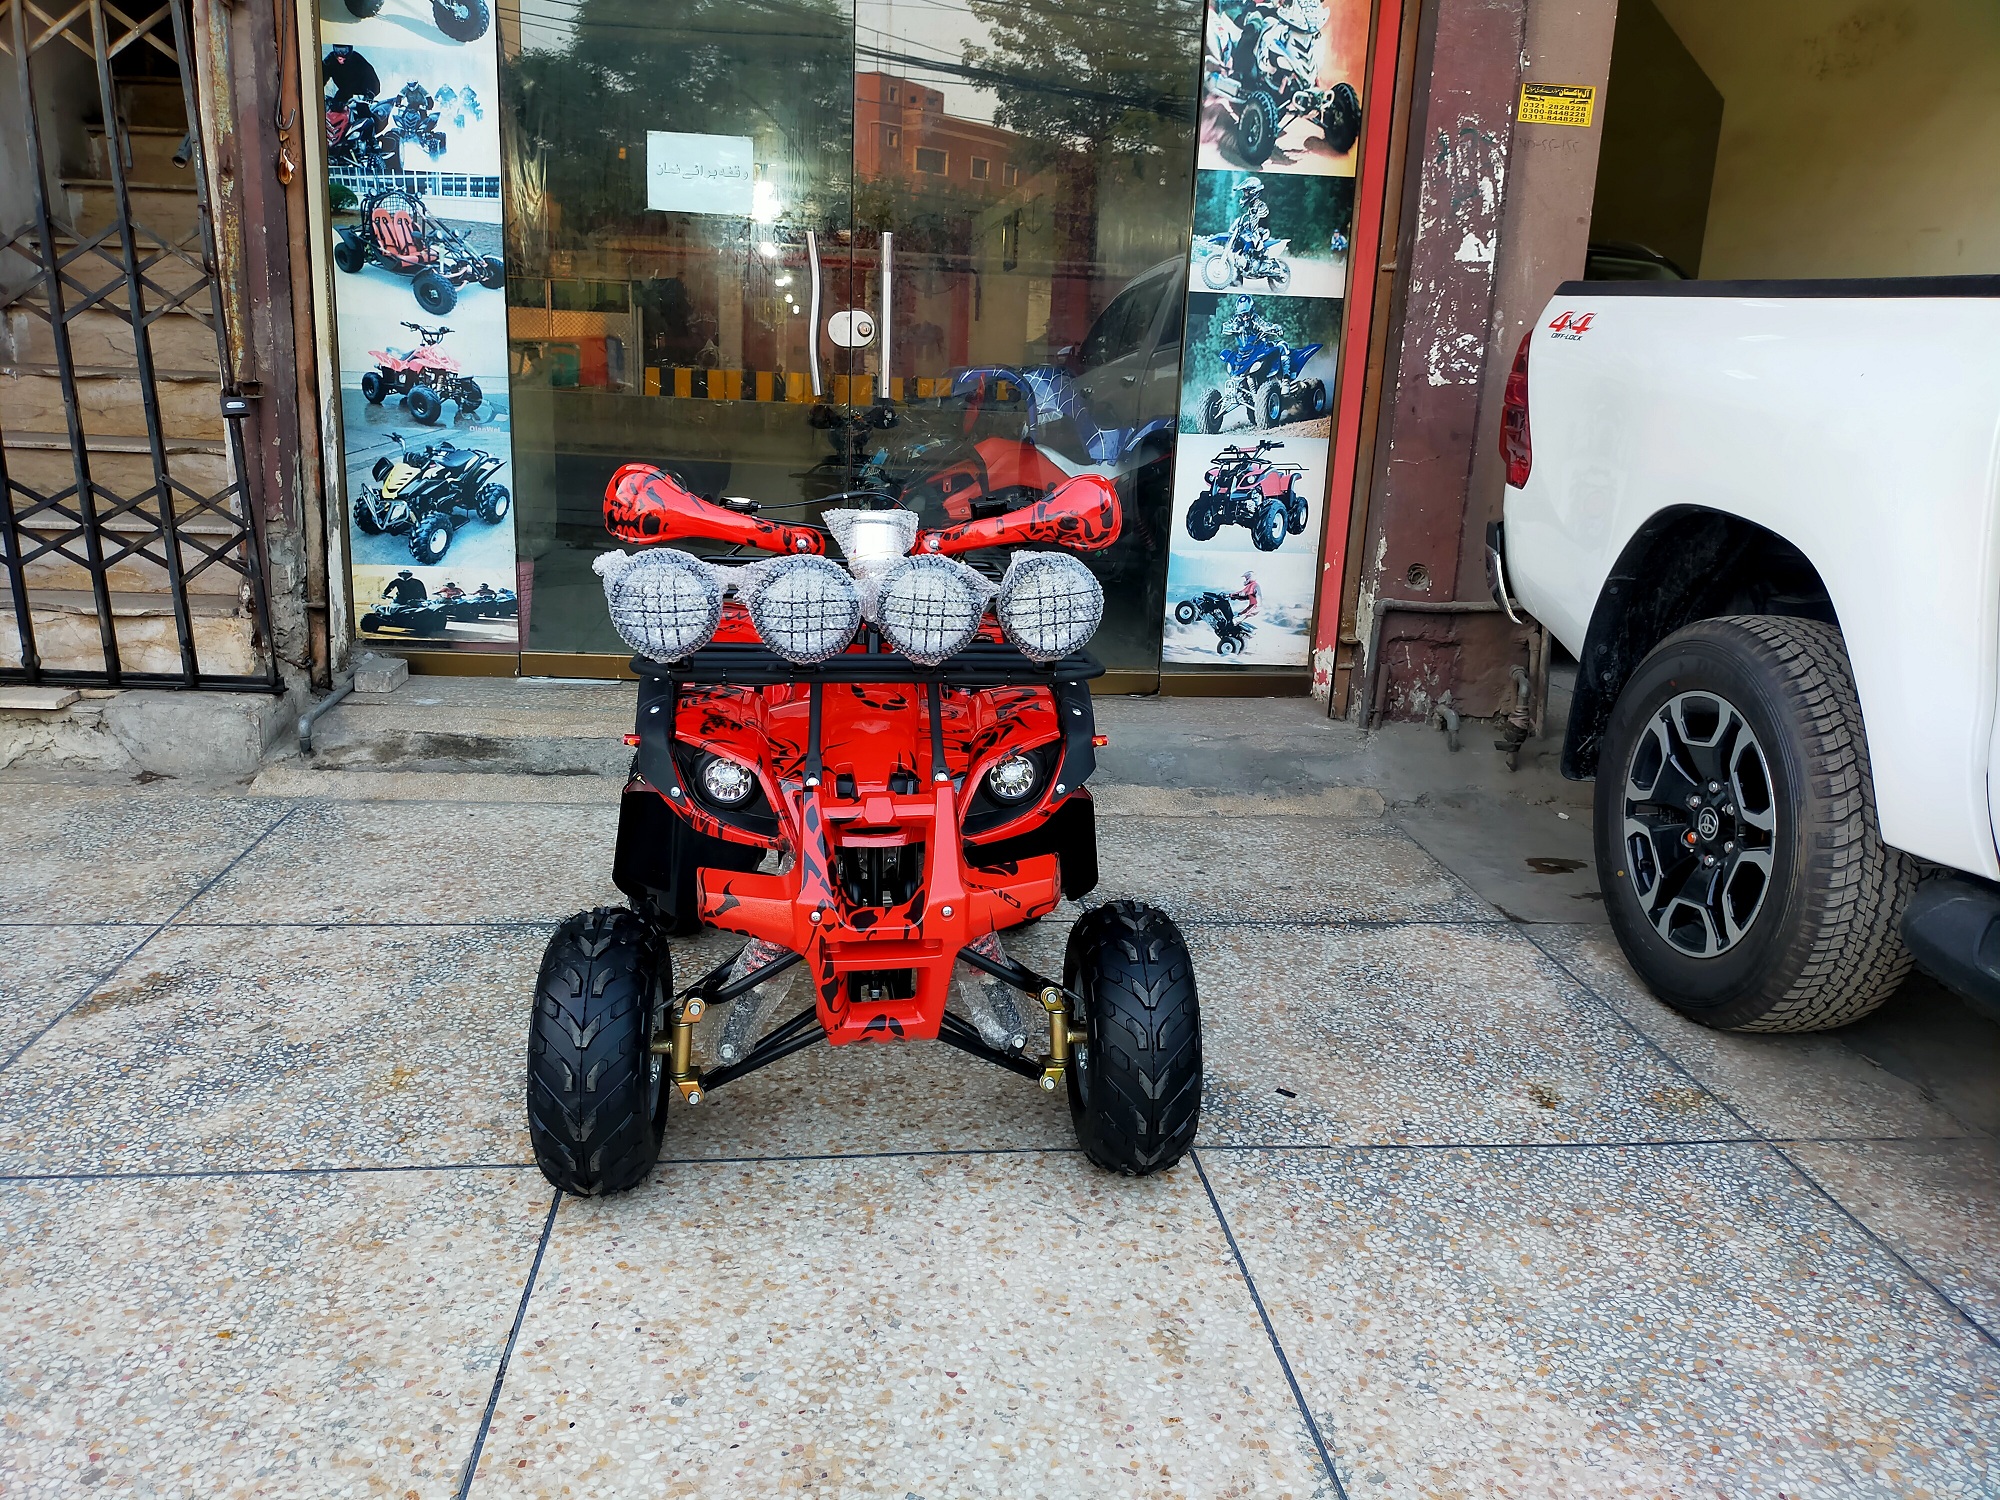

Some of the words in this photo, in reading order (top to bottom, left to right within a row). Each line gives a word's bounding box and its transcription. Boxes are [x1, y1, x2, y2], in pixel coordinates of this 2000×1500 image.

[1523, 102, 1587, 112] 0321-2828228
[1522, 108, 1586, 118] 0300-8448228
[1521, 114, 1585, 123] 0313-8448228
[656, 162, 681, 176] نماز
